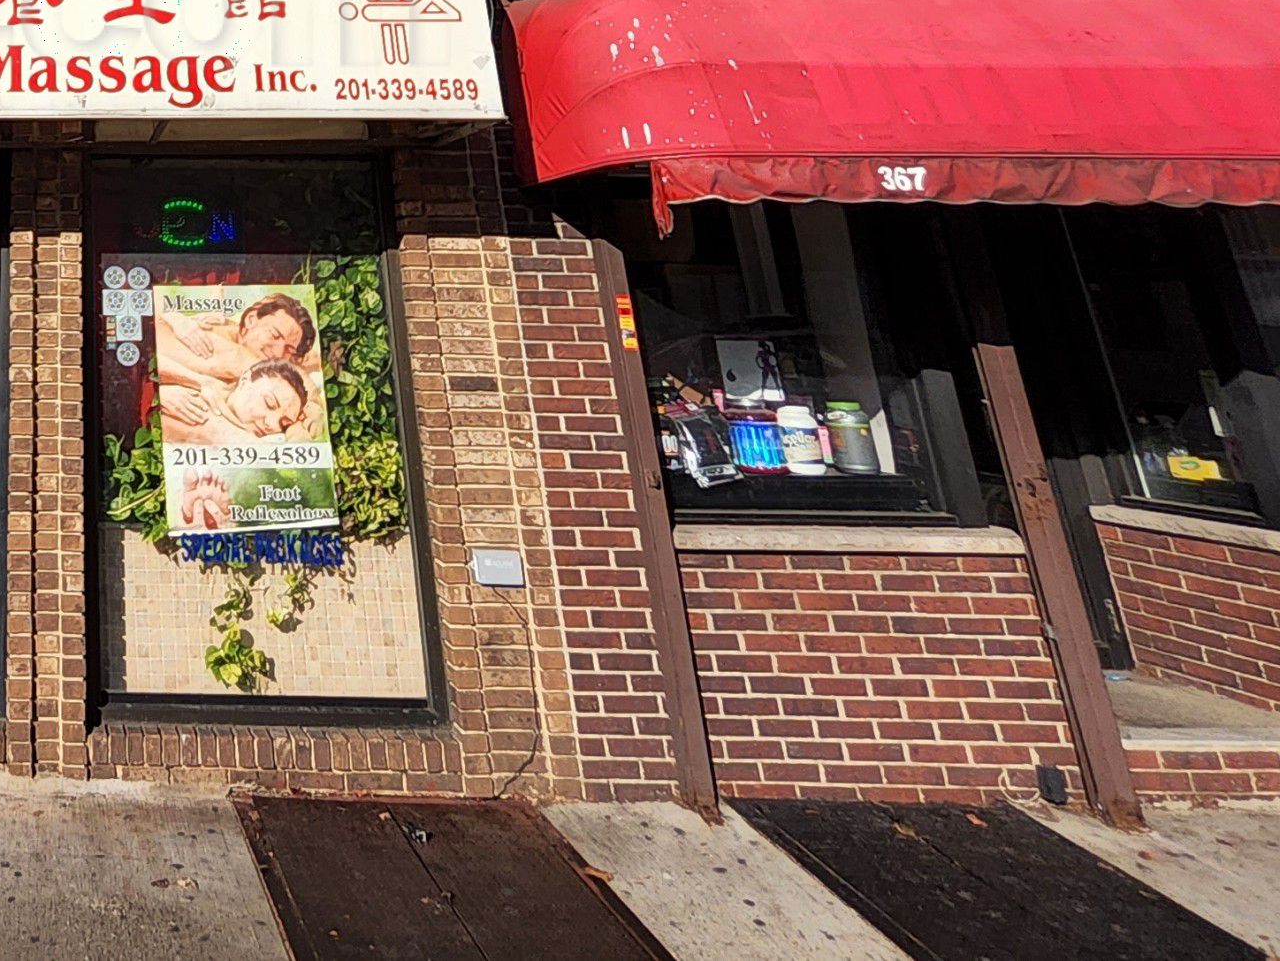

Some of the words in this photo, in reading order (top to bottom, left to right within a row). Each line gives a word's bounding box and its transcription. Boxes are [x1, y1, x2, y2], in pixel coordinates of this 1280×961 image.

[255, 64, 318, 92] Inc.
[334, 78, 479, 102] 201-339-4589
[877, 165, 927, 192] 367
[162, 294, 245, 317] Massage
[172, 446, 321, 466] 201-339-4589
[259, 485, 302, 502] Foot
